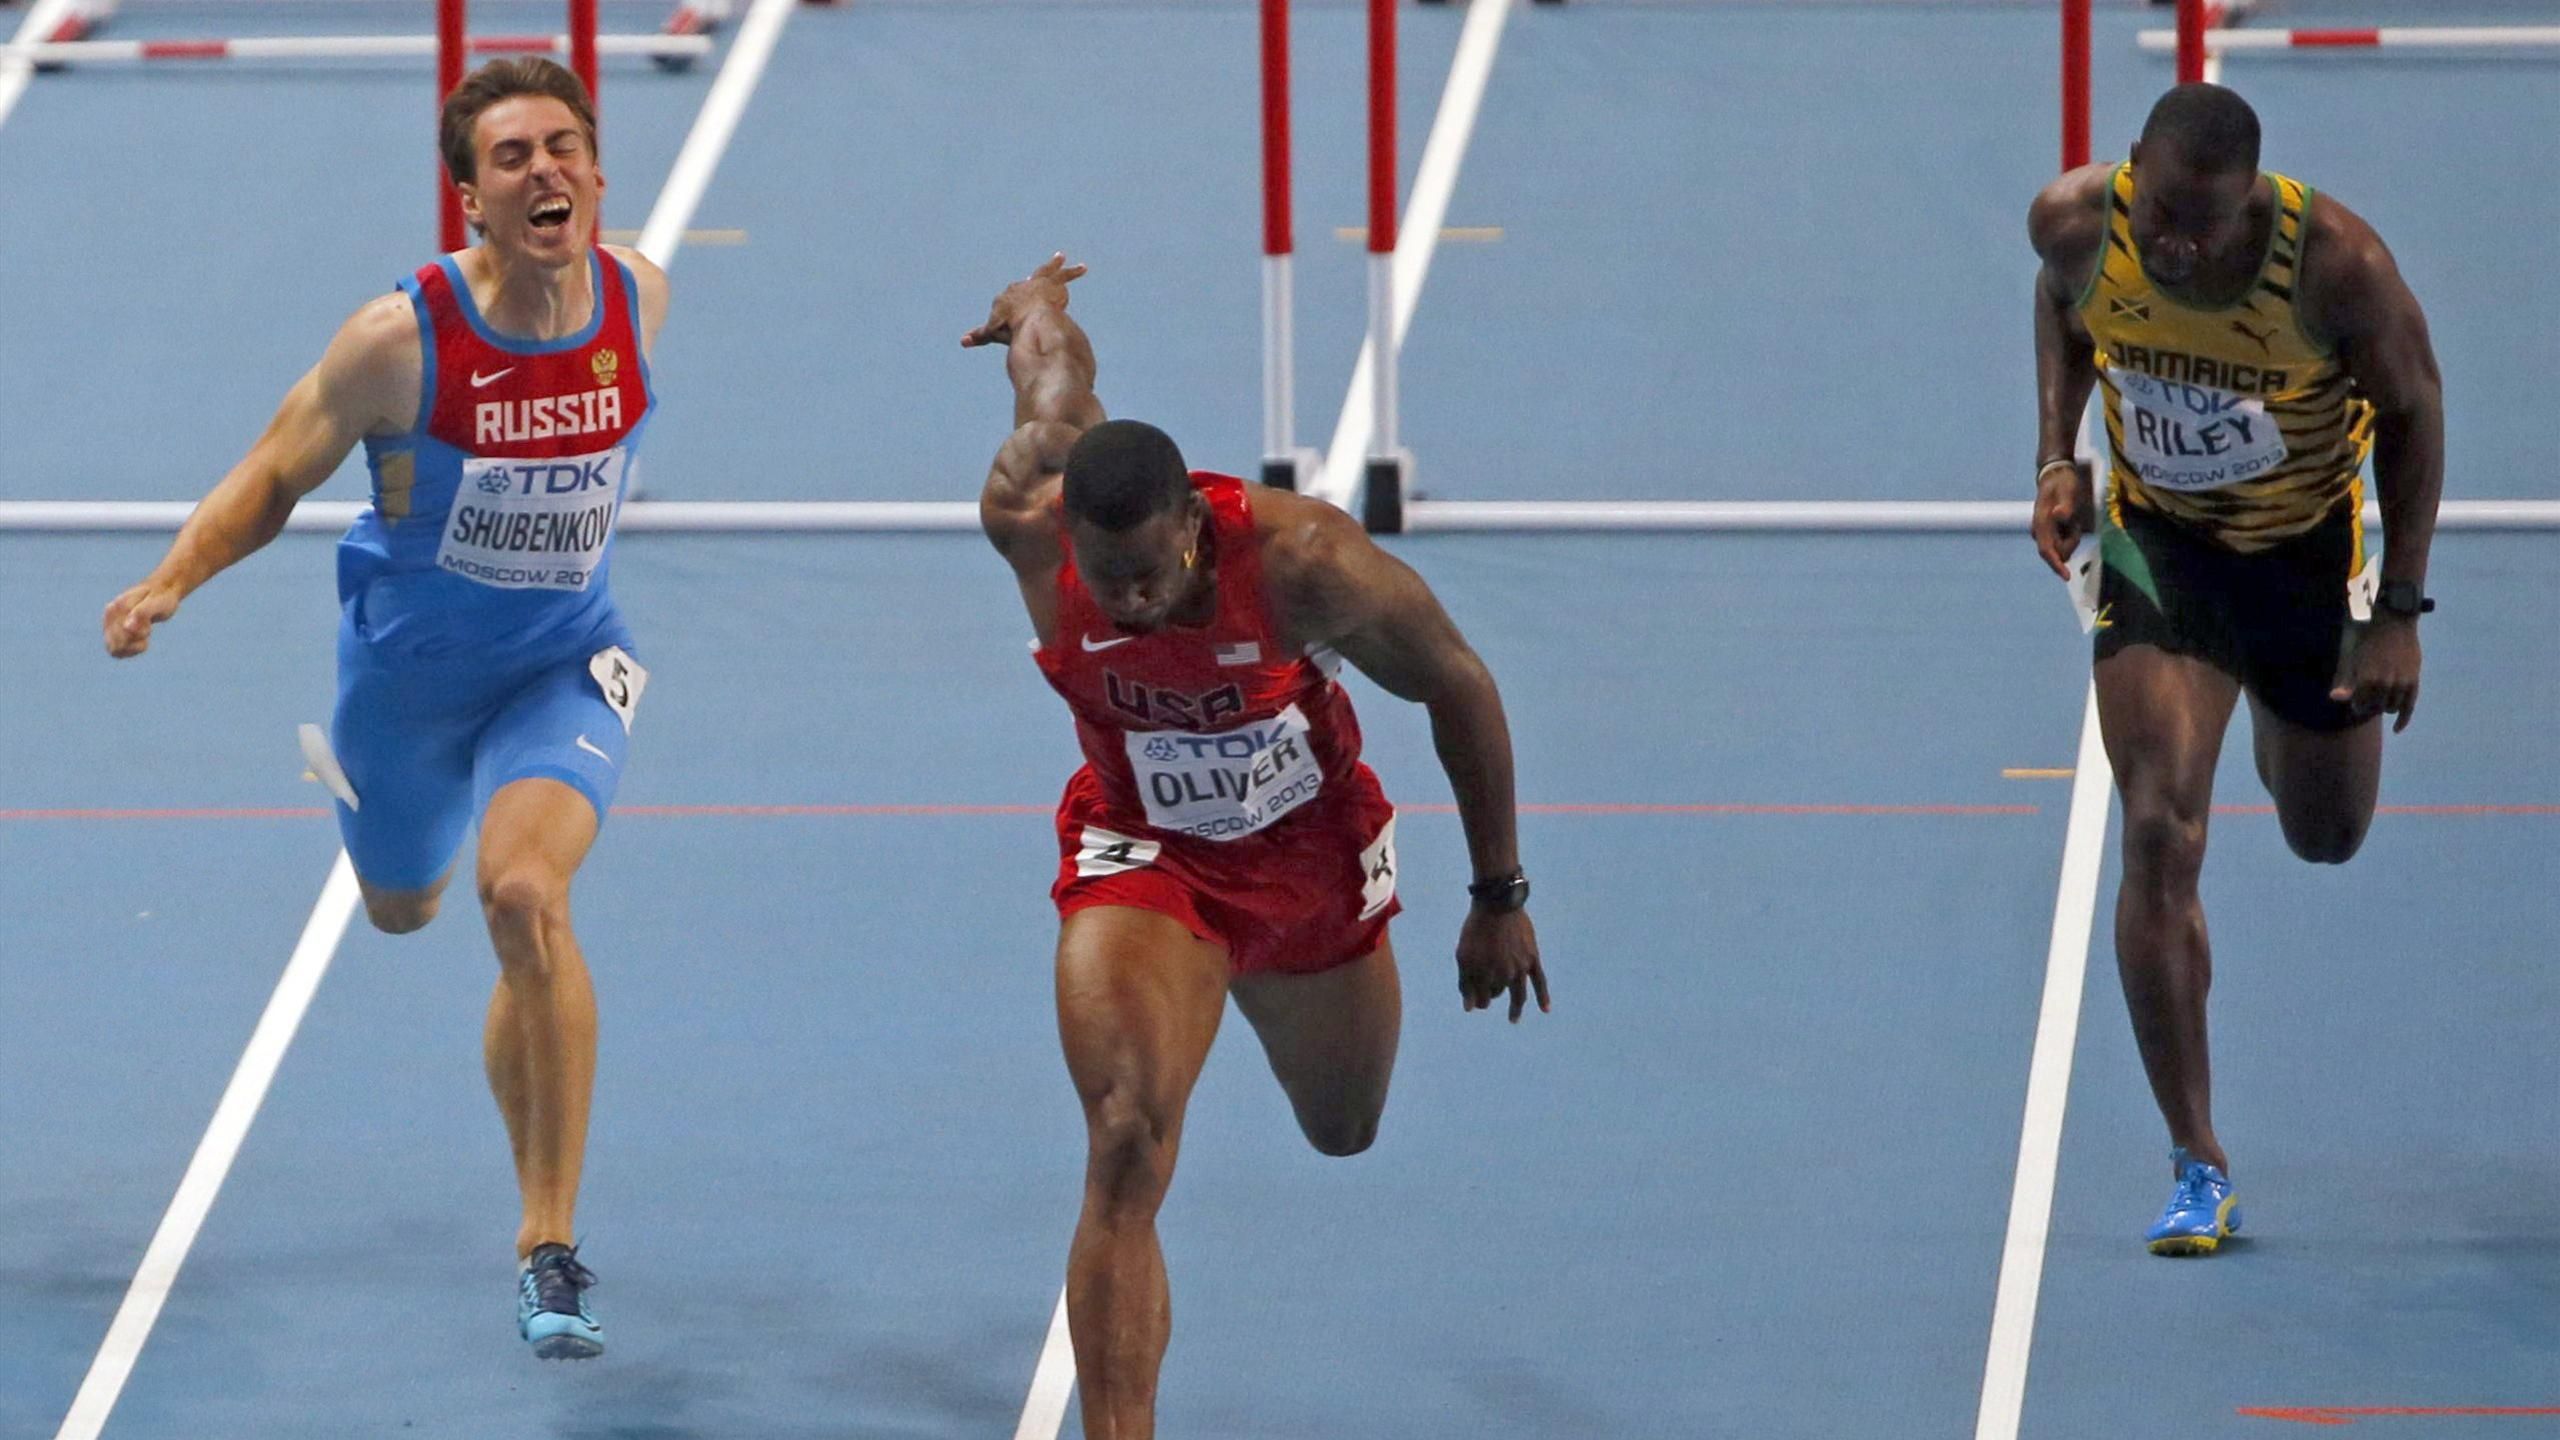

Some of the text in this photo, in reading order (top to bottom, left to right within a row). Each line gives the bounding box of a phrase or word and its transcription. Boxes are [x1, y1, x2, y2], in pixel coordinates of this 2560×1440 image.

[2108, 341, 2288, 392] JAMAICA
[475, 386, 622, 445] RUSSIA
[2135, 405, 2253, 456] RILEY
[513, 457, 610, 495] TDK
[452, 503, 613, 552] SHUBENKOV
[443, 555, 550, 583] MOSCOW
[610, 658, 630, 708] 5
[1105, 671, 1243, 729] USA
[1177, 721, 1288, 758] TDK
[1152, 736, 1300, 808] OLIVER
[1181, 773, 1319, 838] OSCOW 2013
[1095, 842, 1134, 863] 4
